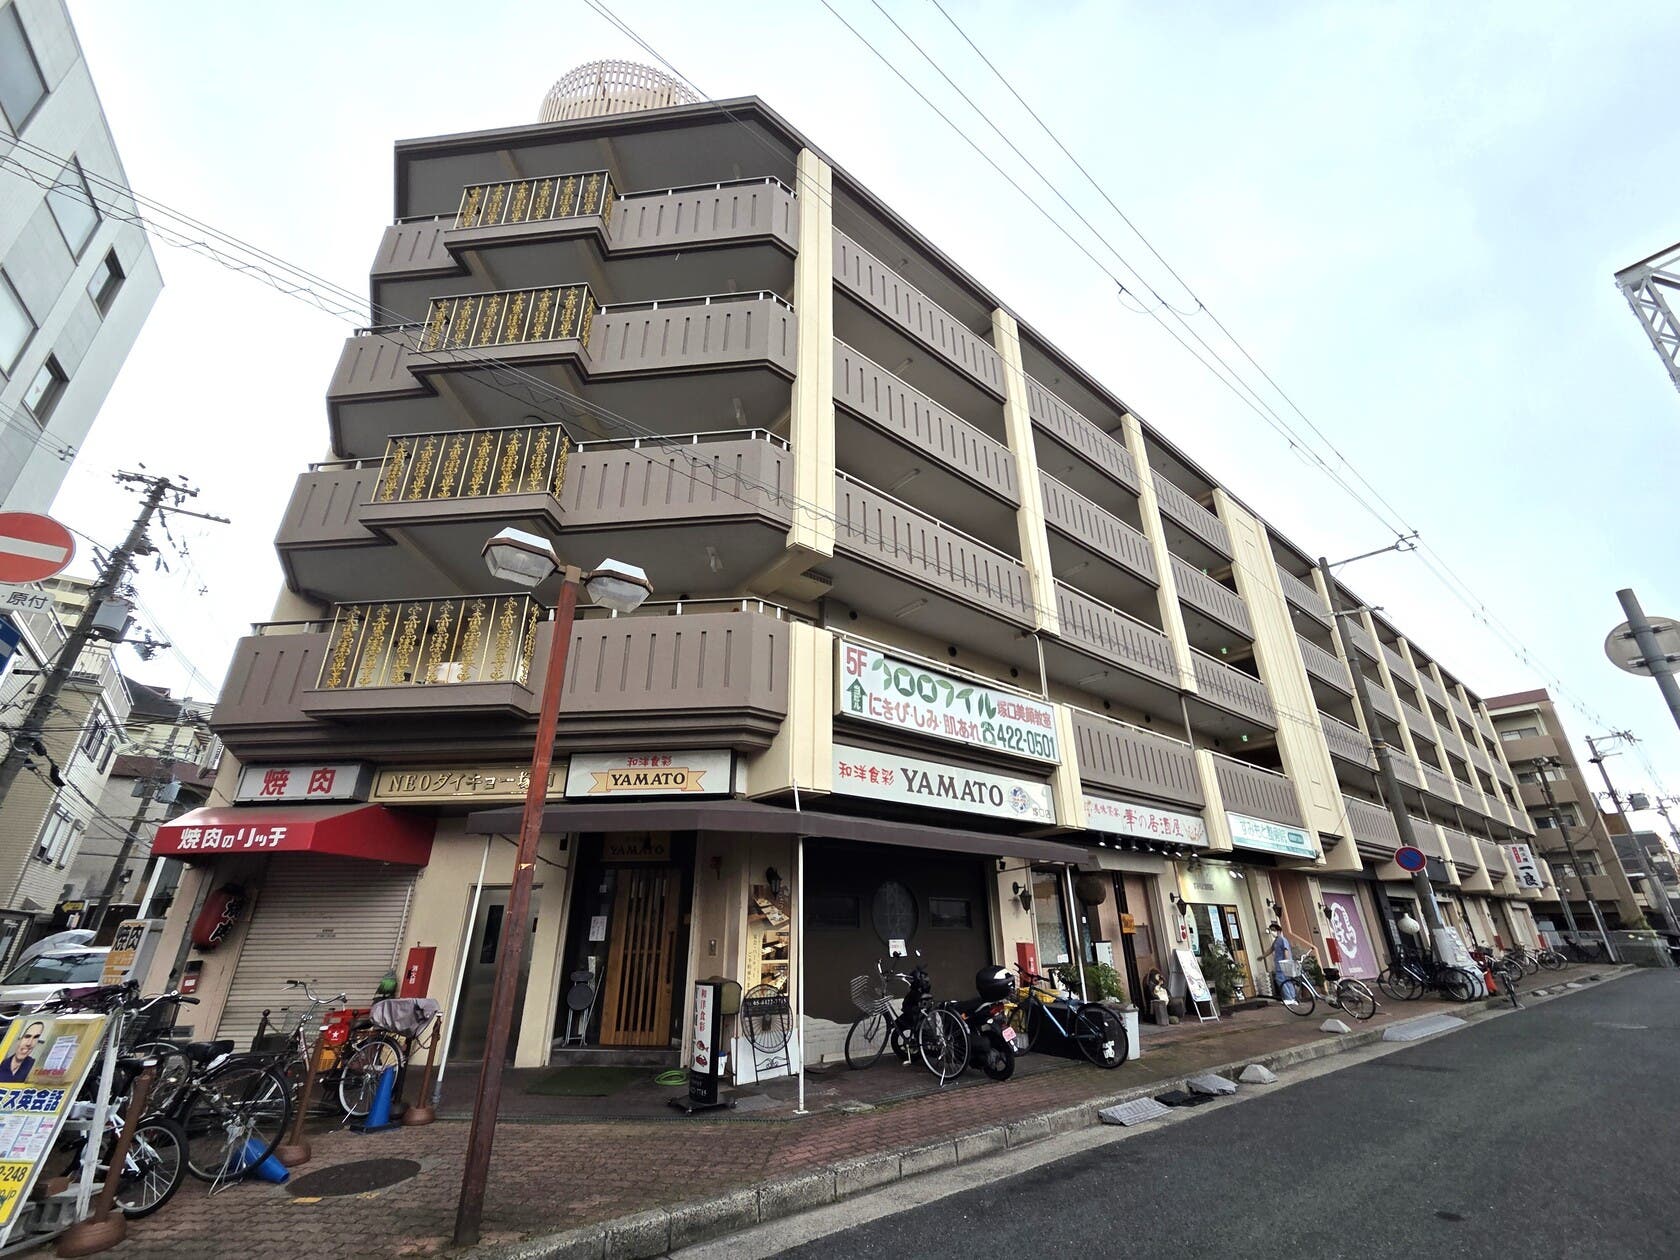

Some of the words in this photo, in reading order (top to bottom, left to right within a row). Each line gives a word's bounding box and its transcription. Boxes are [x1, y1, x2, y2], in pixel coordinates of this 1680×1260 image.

[846, 647, 867, 677] 5F
[997, 700, 1051, 729] 塚口美顔教室
[997, 723, 1057, 760] 422-0501
[626, 756, 673, 768] 和洋食彩
[259, 768, 336, 796] 焼肉
[388, 771, 555, 792] NEOダイキョー塚
[611, 772, 686, 786] YAMATO
[838, 761, 895, 786] 和洋食彩
[900, 767, 1004, 807] YAMATO
[177, 826, 287, 850] 焼肉のリッチ
[111, 924, 145, 951] 焼肉
